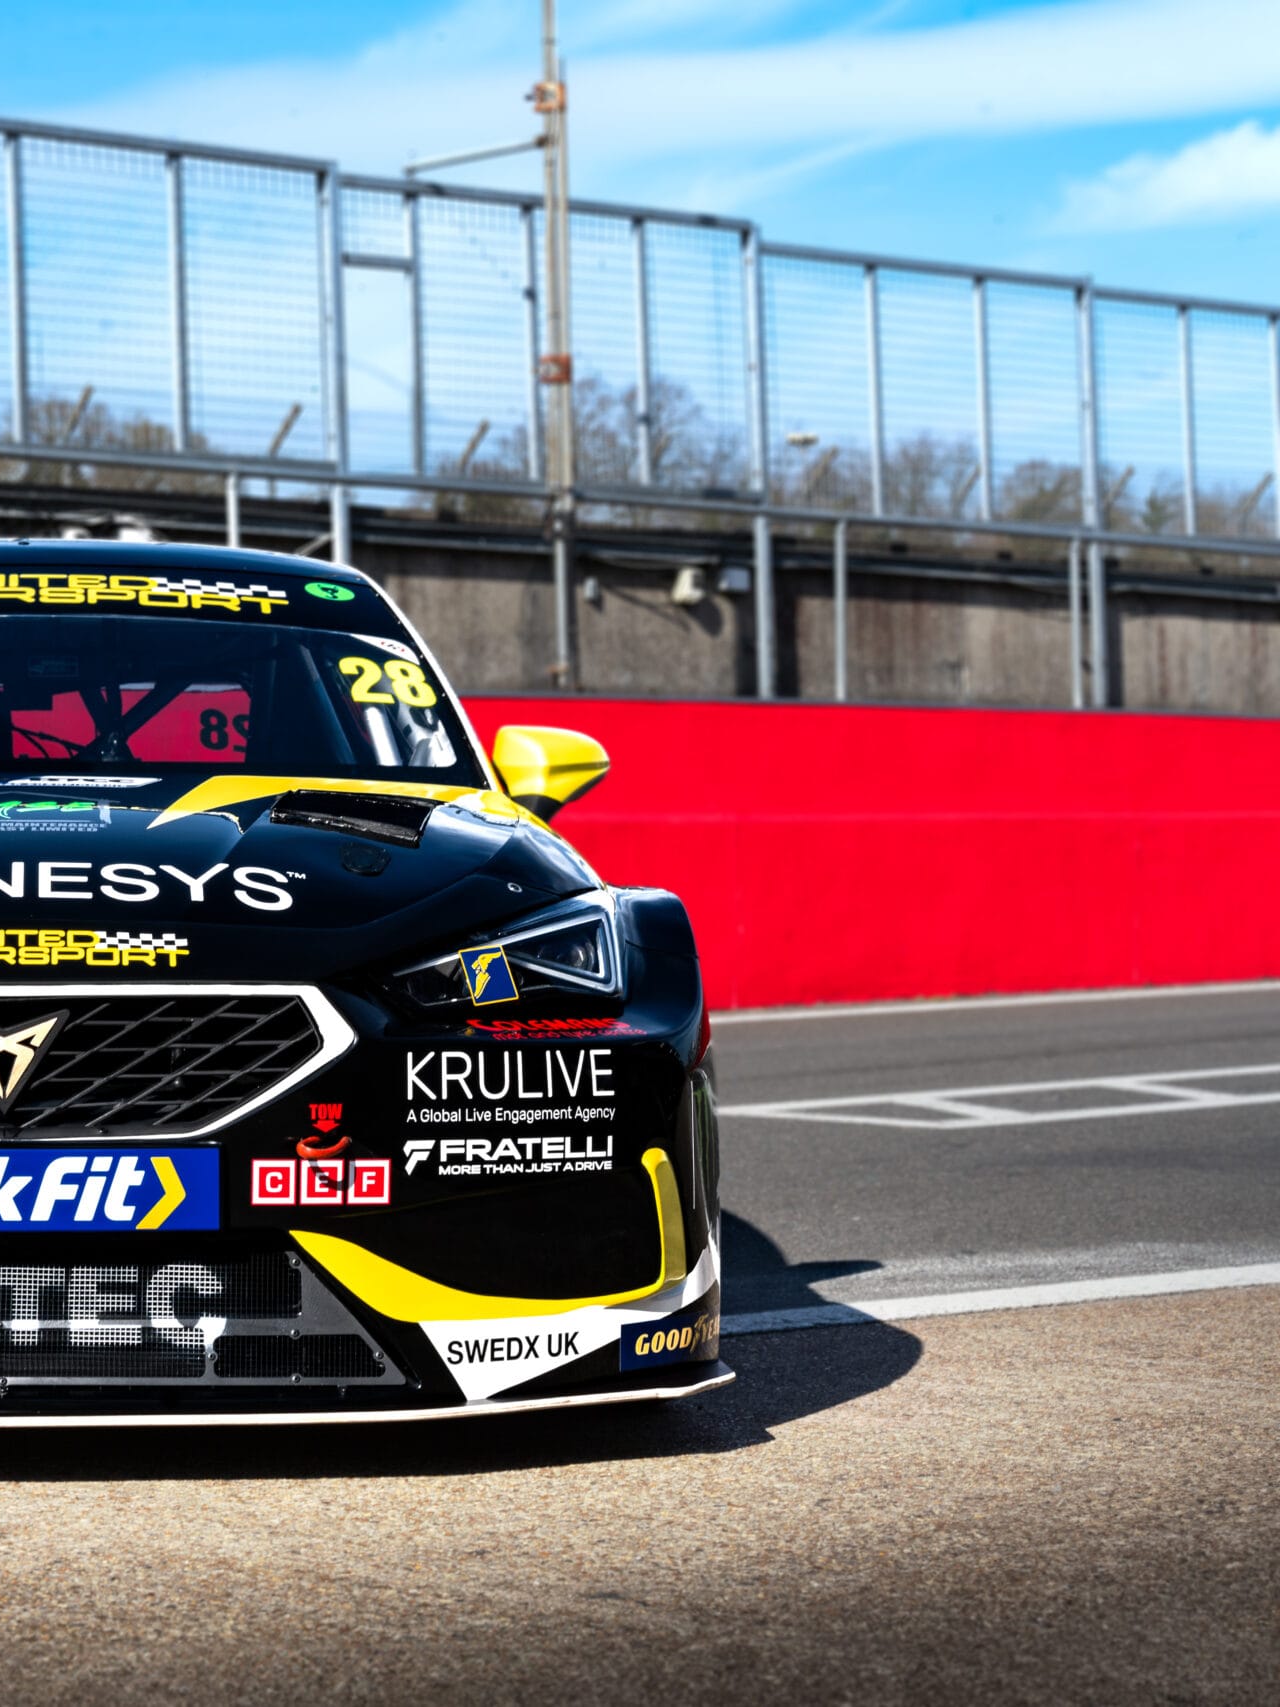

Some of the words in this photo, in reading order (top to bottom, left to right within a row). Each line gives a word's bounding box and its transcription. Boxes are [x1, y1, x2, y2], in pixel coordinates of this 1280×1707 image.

[338, 656, 438, 708] 28
[406, 1048, 615, 1100] KRULIVE
[308, 1103, 343, 1121] TOW
[406, 1109, 417, 1122] A
[419, 1108, 461, 1123] Global
[464, 1107, 492, 1122] Live
[494, 1106, 572, 1124] Engagement
[574, 1105, 616, 1122] Agency
[439, 1135, 613, 1162] FRATELLI
[438, 1164, 481, 1175] MORE
[483, 1163, 524, 1175] THAN
[524, 1162, 562, 1173] JUST
[562, 1162, 575, 1172] A
[575, 1160, 613, 1171] DRIVE
[446, 1335, 540, 1365] SWEDX
[546, 1331, 580, 1358] UK
[635, 1314, 720, 1356] GOODYEA
